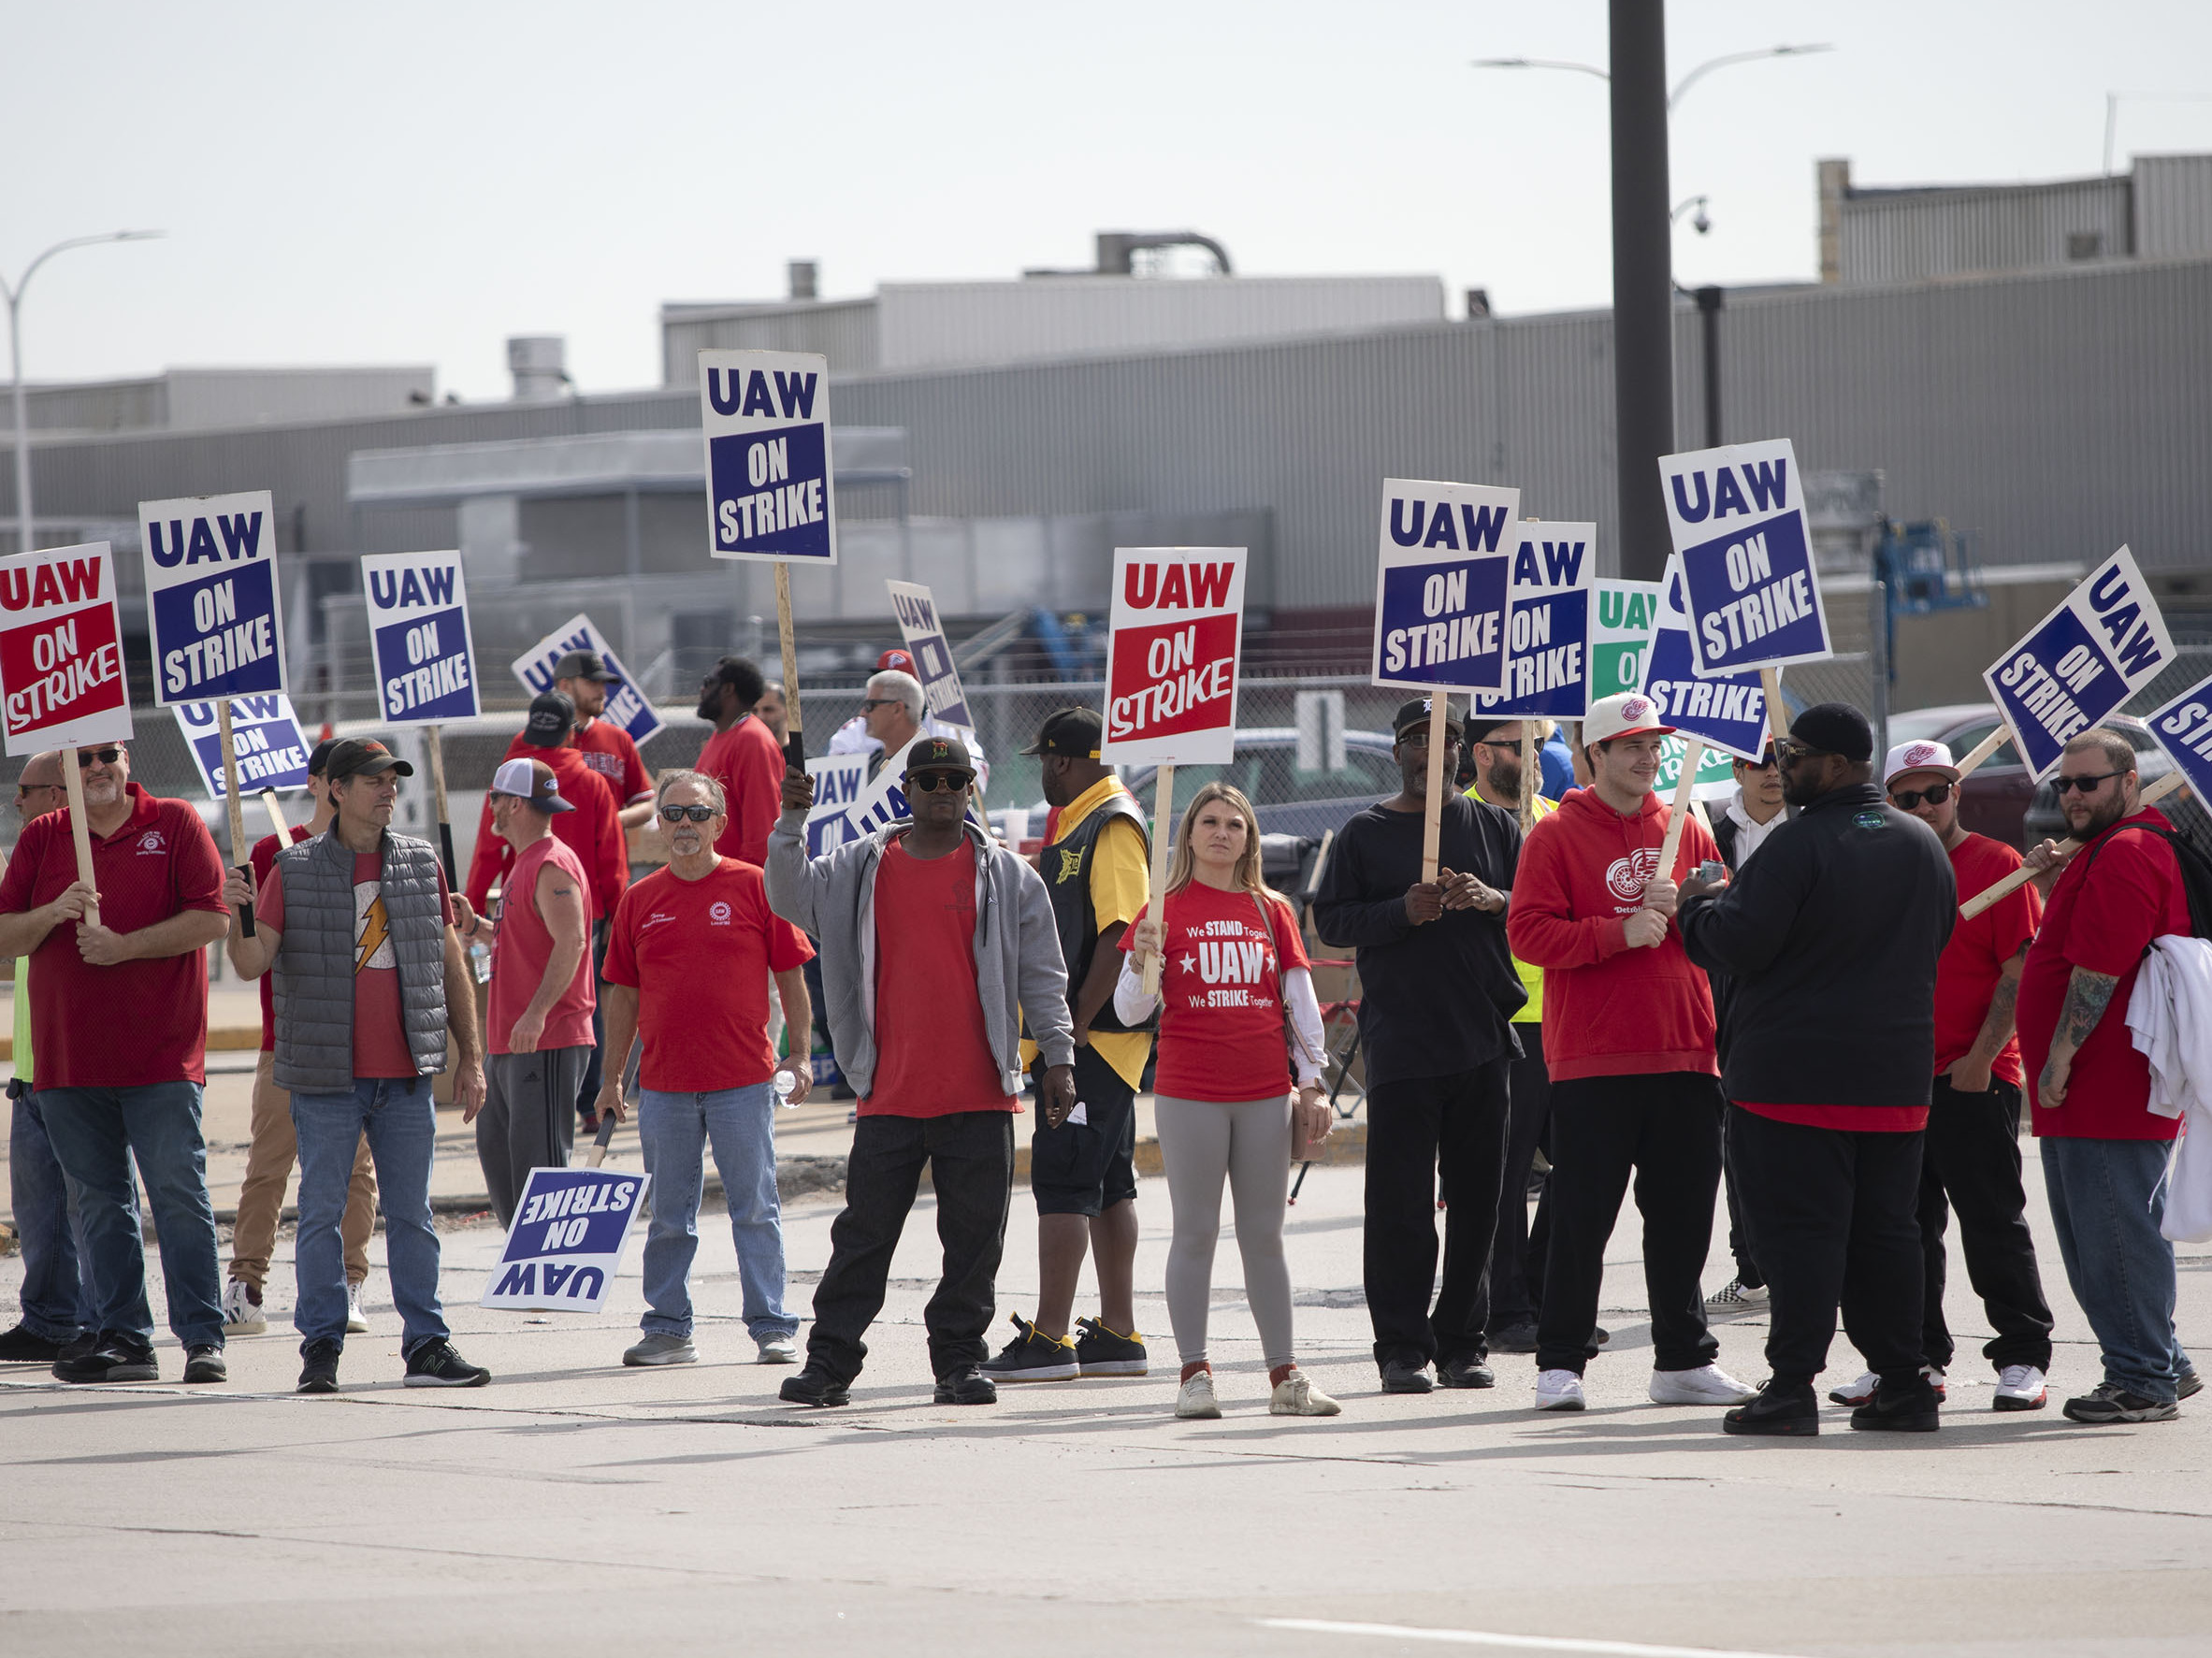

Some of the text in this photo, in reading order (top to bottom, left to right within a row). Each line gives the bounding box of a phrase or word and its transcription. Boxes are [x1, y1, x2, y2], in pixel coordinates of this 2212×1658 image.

[708, 368, 818, 420] UAW
[748, 437, 789, 488] ON
[719, 478, 824, 544] STRIKE
[1670, 458, 1786, 524] UAW
[149, 512, 263, 568] UAW
[1390, 497, 1509, 553] UAW
[0, 556, 102, 612] UAW
[1124, 562, 1236, 609] UAW
[1513, 541, 1586, 586] AW
[1725, 531, 1772, 592] ON
[193, 579, 236, 633] ON
[369, 566, 455, 610] UAW
[893, 593, 936, 632] UAW
[1423, 569, 1467, 618] ON
[1511, 603, 1551, 652] ON
[1701, 569, 1814, 660] STRIKE
[2089, 563, 2162, 679] UAW
[33, 618, 79, 671] ON
[165, 613, 273, 694] STRIKE
[406, 621, 440, 665] ON
[921, 642, 943, 678] ON
[1148, 625, 1196, 678] ON
[1385, 611, 1499, 672] STRIKE
[7, 642, 120, 731] STRIKE
[386, 652, 470, 715] STRIKE
[925, 673, 962, 714] STRIKE
[2055, 644, 2104, 695] ON
[1110, 656, 1234, 738] STRIKE
[1649, 680, 1765, 723] STRIKE
[2000, 652, 2089, 748] STRIKE
[232, 728, 269, 757] ON
[212, 746, 307, 791] STRIKE
[820, 815, 844, 856] ON
[1186, 926, 1205, 939] We
[1205, 920, 1243, 936] STAND
[1198, 942, 1264, 984] UAW
[1188, 995, 1206, 1008] We
[1207, 989, 1250, 1007] STRIKE
[521, 1181, 636, 1226] STRIKE
[541, 1217, 590, 1251] ON
[492, 1262, 605, 1301] UAW
